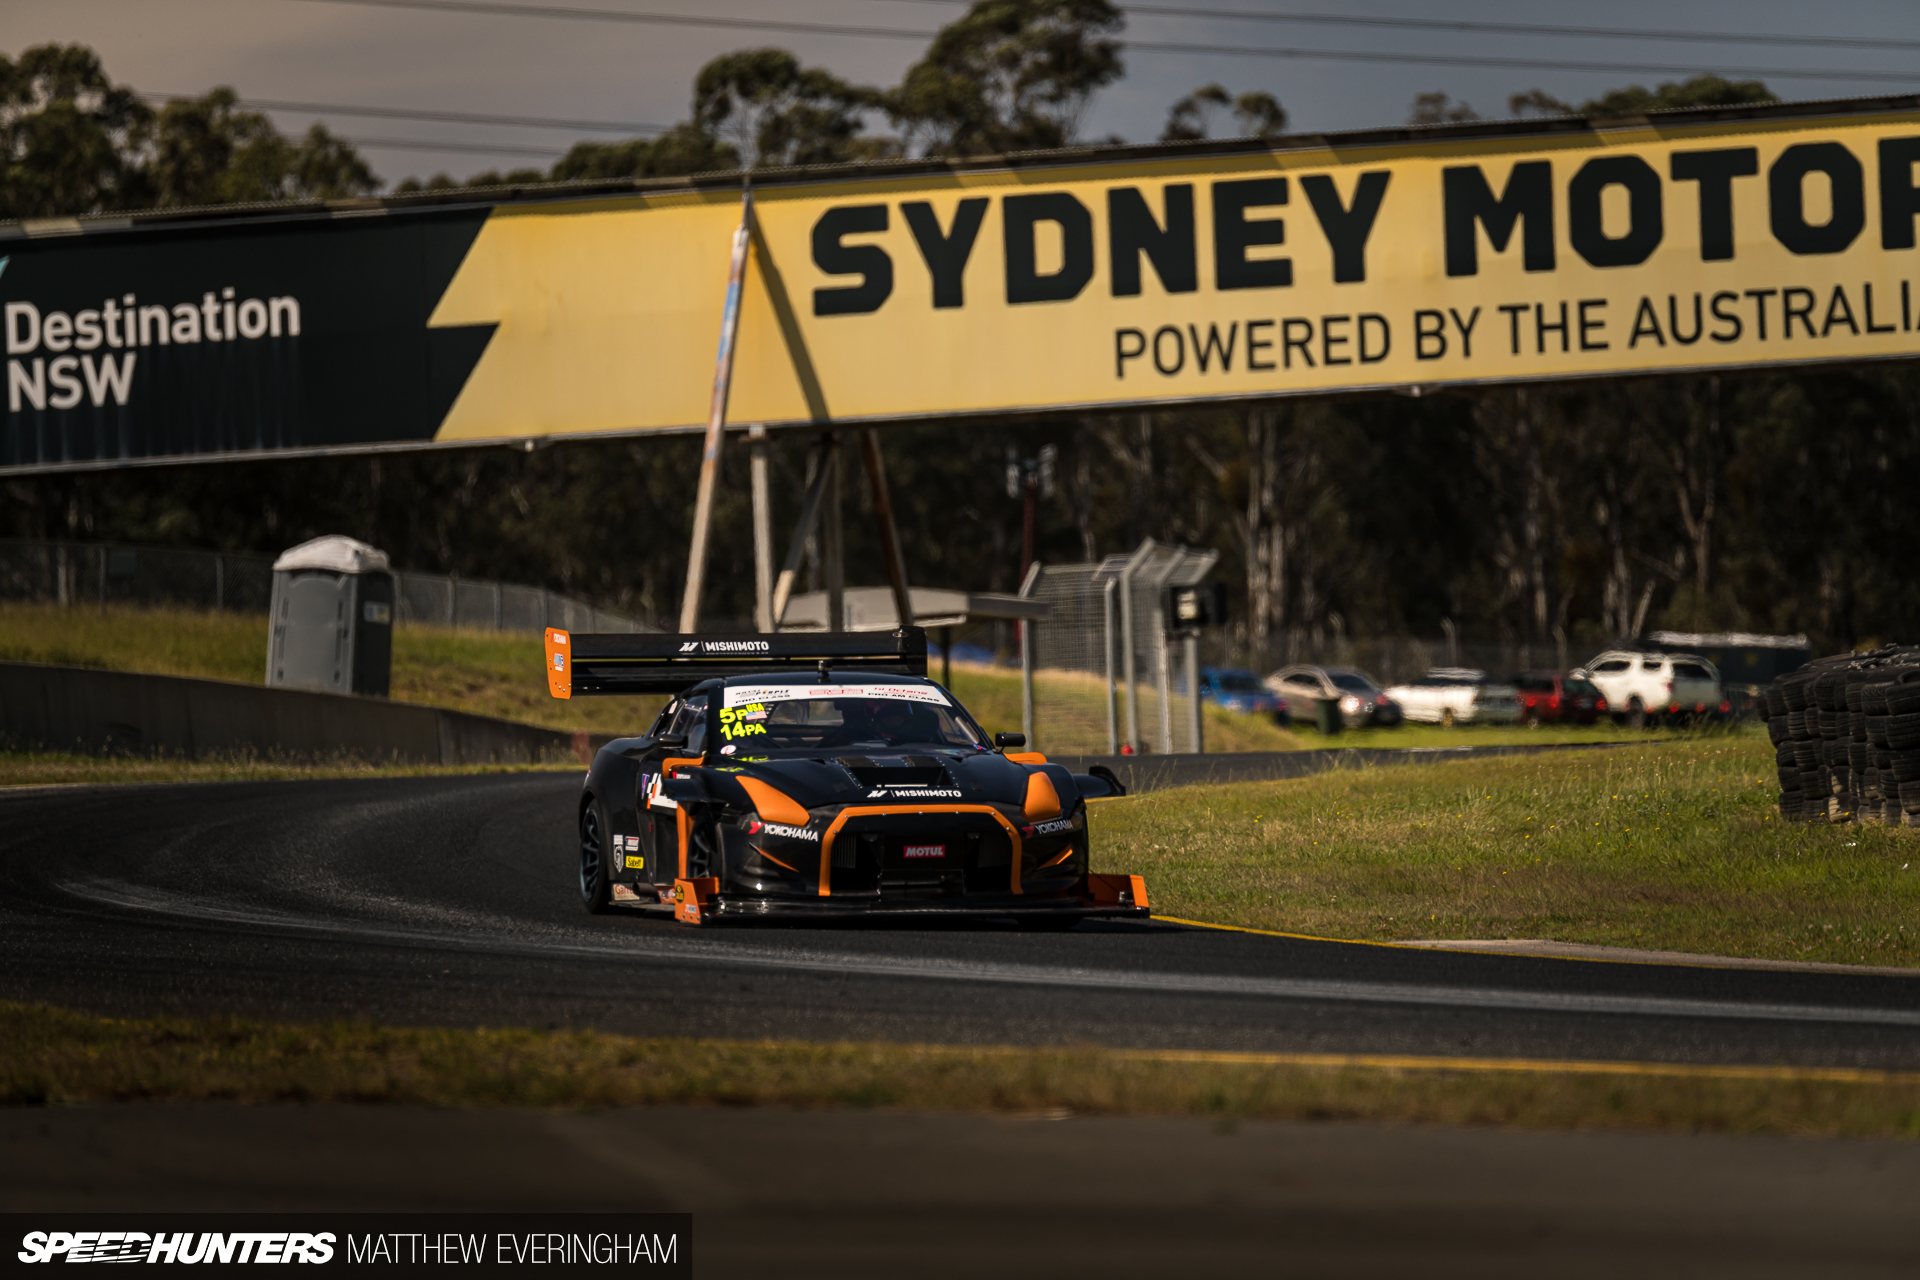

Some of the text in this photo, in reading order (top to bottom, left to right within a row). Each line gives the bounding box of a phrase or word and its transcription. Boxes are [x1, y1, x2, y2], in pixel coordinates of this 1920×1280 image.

[810, 170, 1392, 318] SYDNEY
[5, 286, 301, 355] Destination
[1114, 279, 1920, 380] POWERED BY THE AUSTRALI
[7, 351, 137, 413] NSW
[705, 641, 770, 652] MISHIMOTO
[745, 702, 765, 713] USA
[720, 721, 767, 741] 14PA
[894, 789, 962, 798] MISHIMOTO
[763, 823, 819, 842] YOKOHAMA
[1034, 819, 1074, 835] YOKOHAMA
[905, 846, 944, 857] MOTUL
